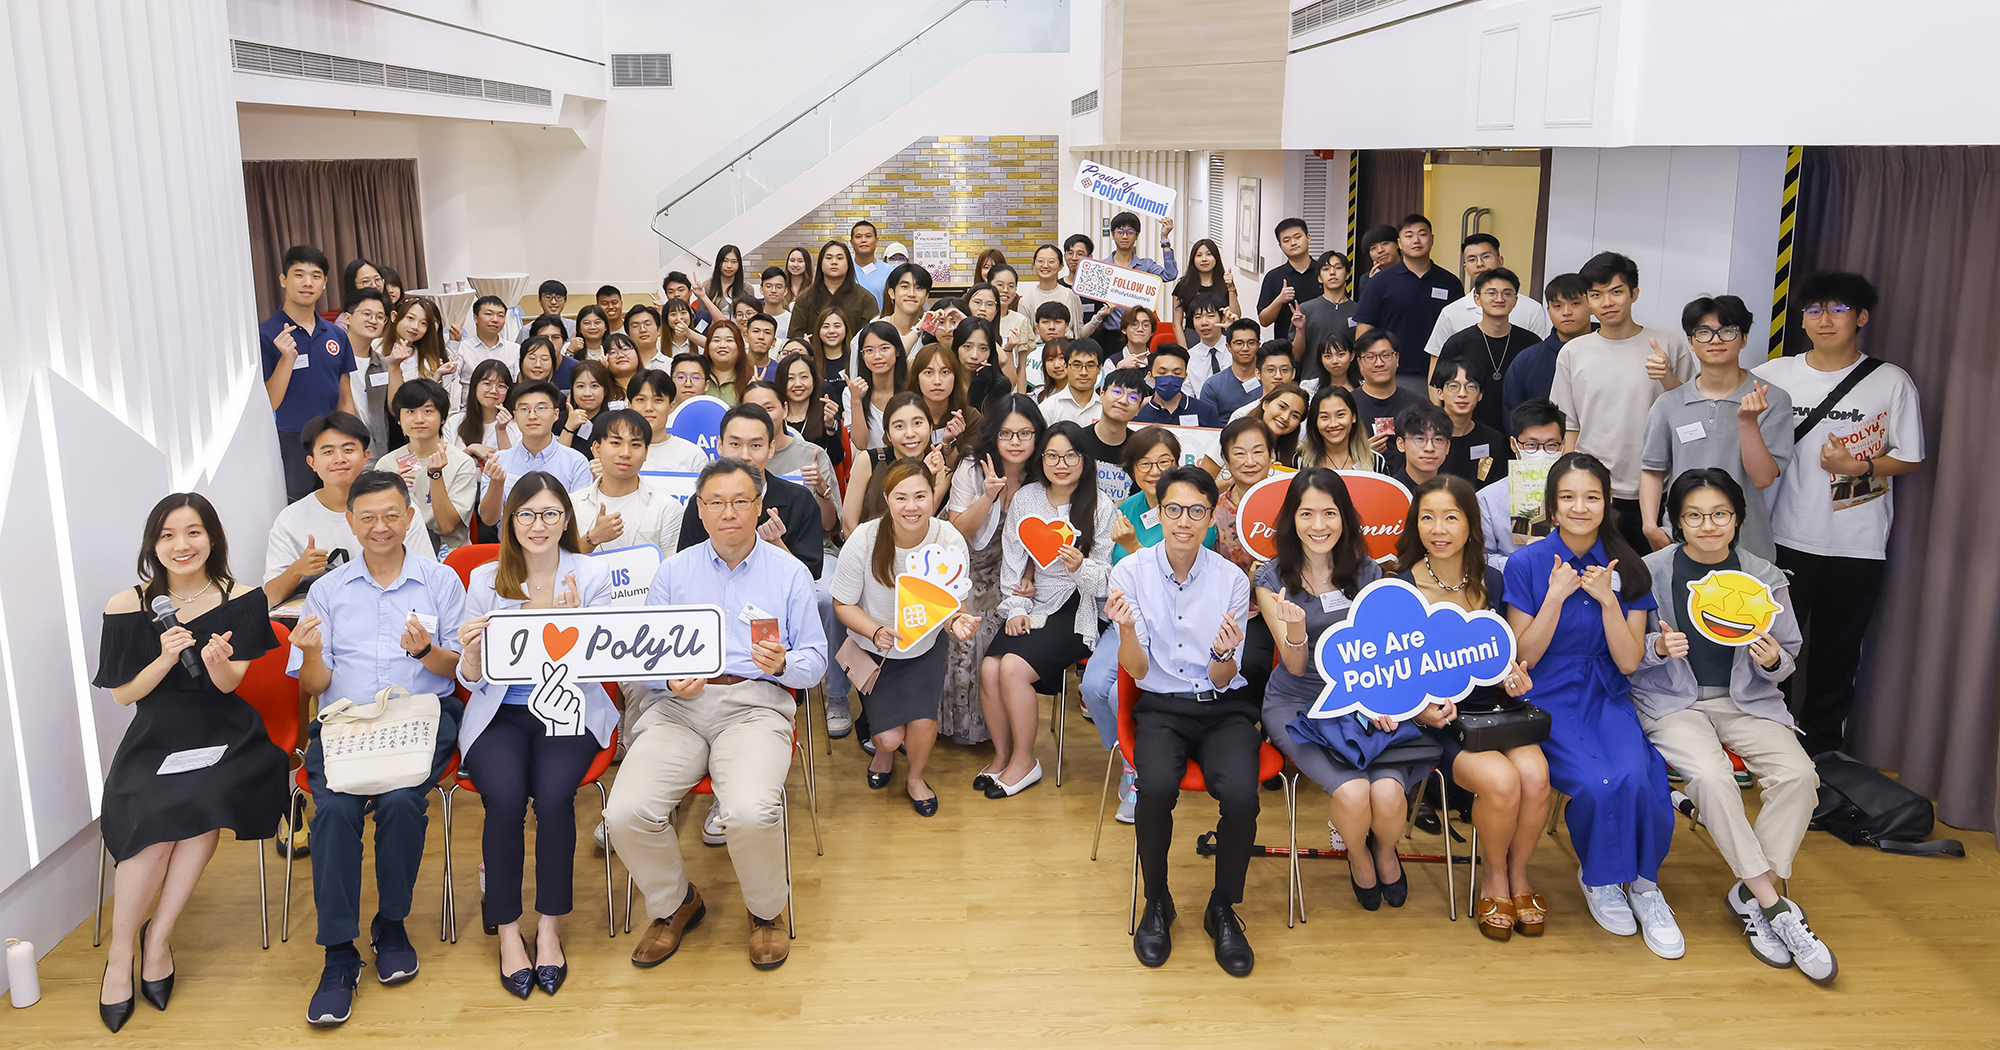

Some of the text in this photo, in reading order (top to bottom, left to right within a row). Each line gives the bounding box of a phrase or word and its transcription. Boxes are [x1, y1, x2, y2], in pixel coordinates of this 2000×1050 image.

[1082, 164, 1139, 194] Proud of
[1091, 179, 1169, 217] PolyU Alumni
[1112, 276, 1157, 297] FOLLOW US
[697, 433, 717, 449] Ar
[1855, 440, 1881, 462] OLYU
[1097, 470, 1126, 481] OLYU
[1359, 518, 1404, 536] mni
[611, 568, 630, 587] US
[509, 623, 706, 671] I PolyU
[1336, 630, 1426, 664] We Are
[1343, 636, 1500, 693] PolyU Alumni
